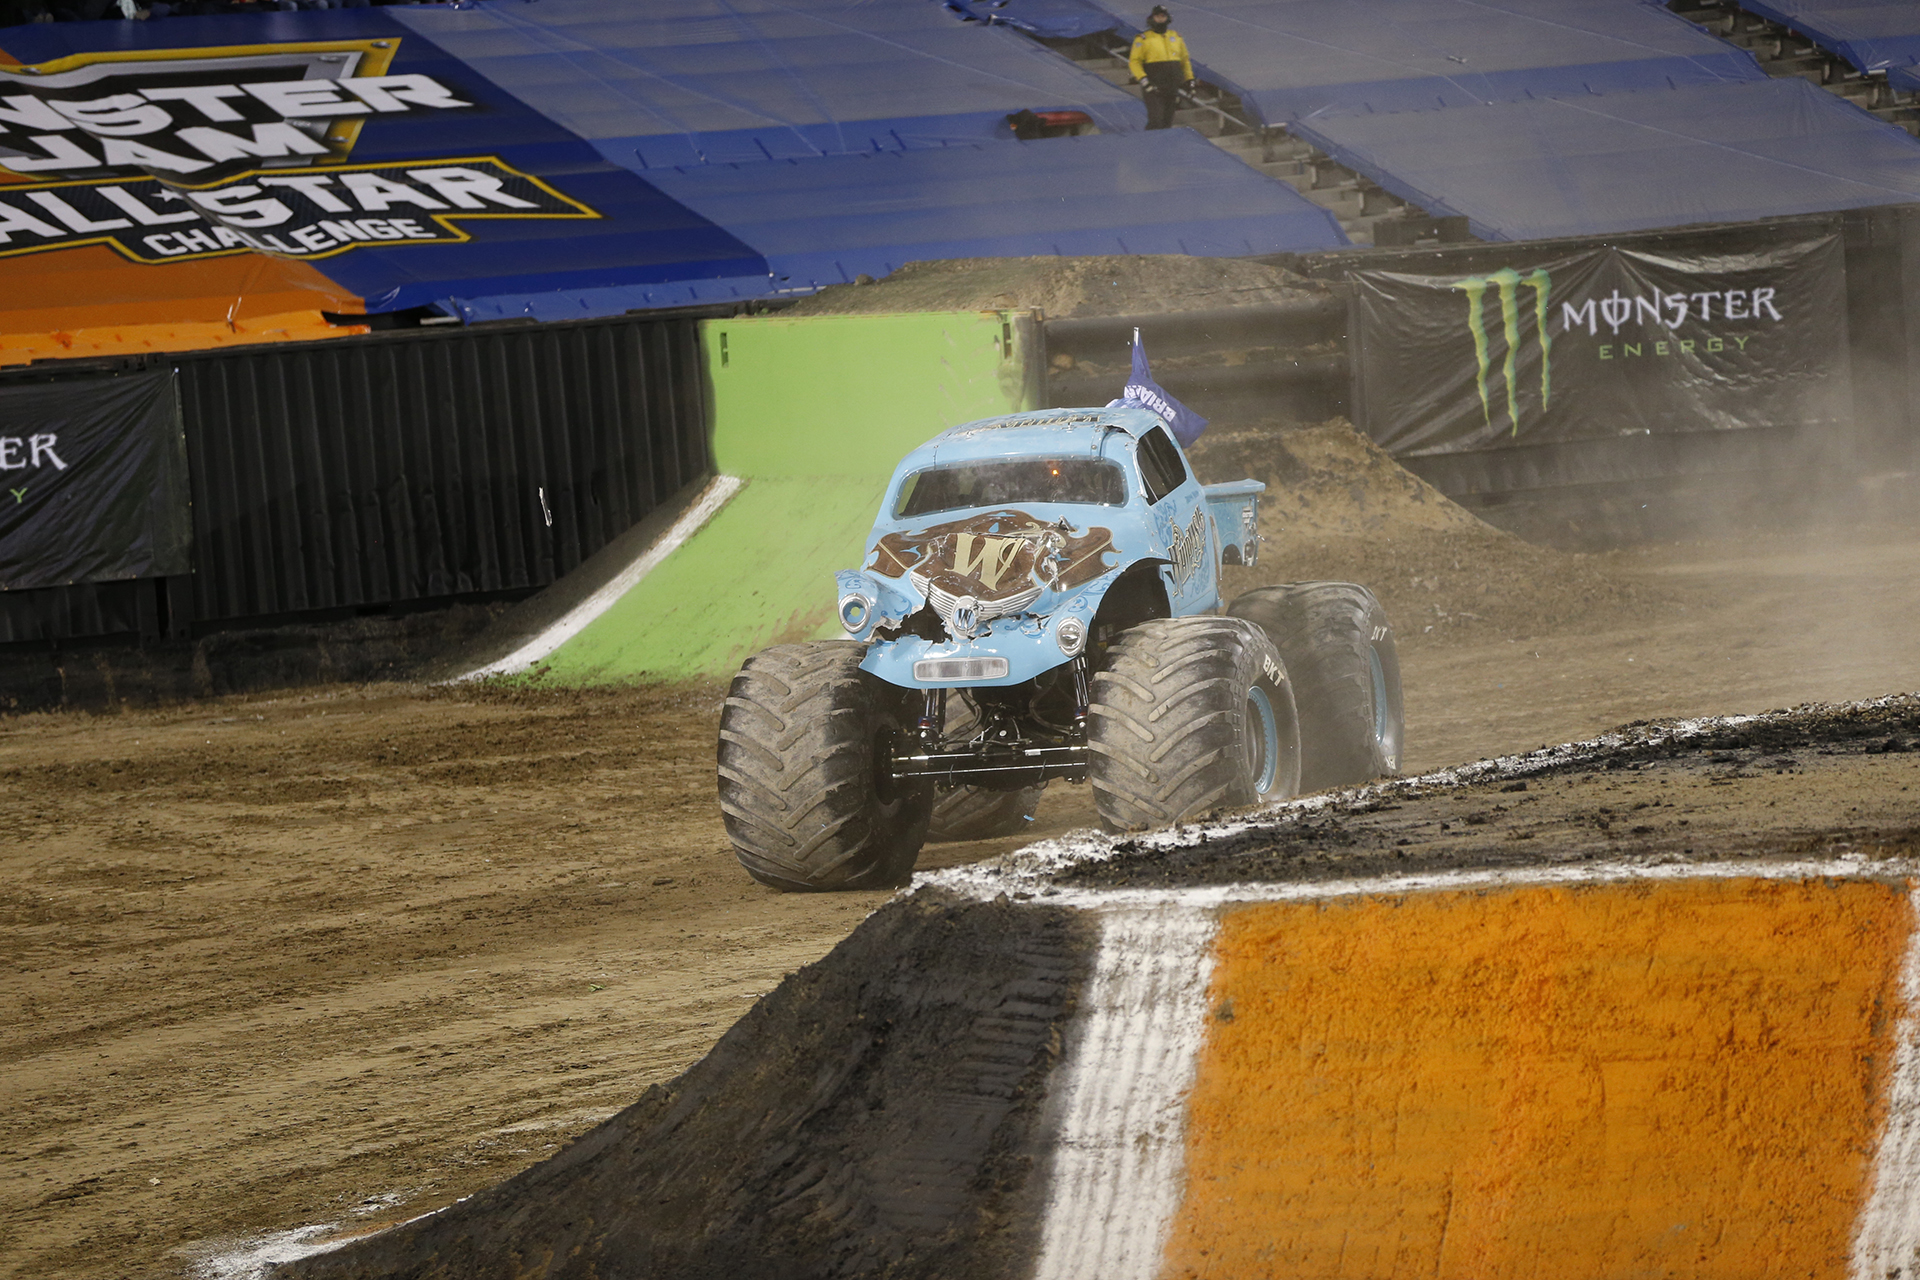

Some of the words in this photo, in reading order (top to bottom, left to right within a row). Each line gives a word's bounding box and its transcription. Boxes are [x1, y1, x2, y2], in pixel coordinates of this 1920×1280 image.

[0, 122, 330, 173] JAM
[186, 167, 541, 228] STAR
[143, 219, 437, 254] CHALLENGE
[1562, 287, 1783, 336] MONSTER
[1599, 336, 1749, 360] ENERGY
[0, 433, 68, 470] ER
[10, 487, 28, 503] Y
[944, 532, 1026, 591] W
[1263, 654, 1285, 687] BKT
